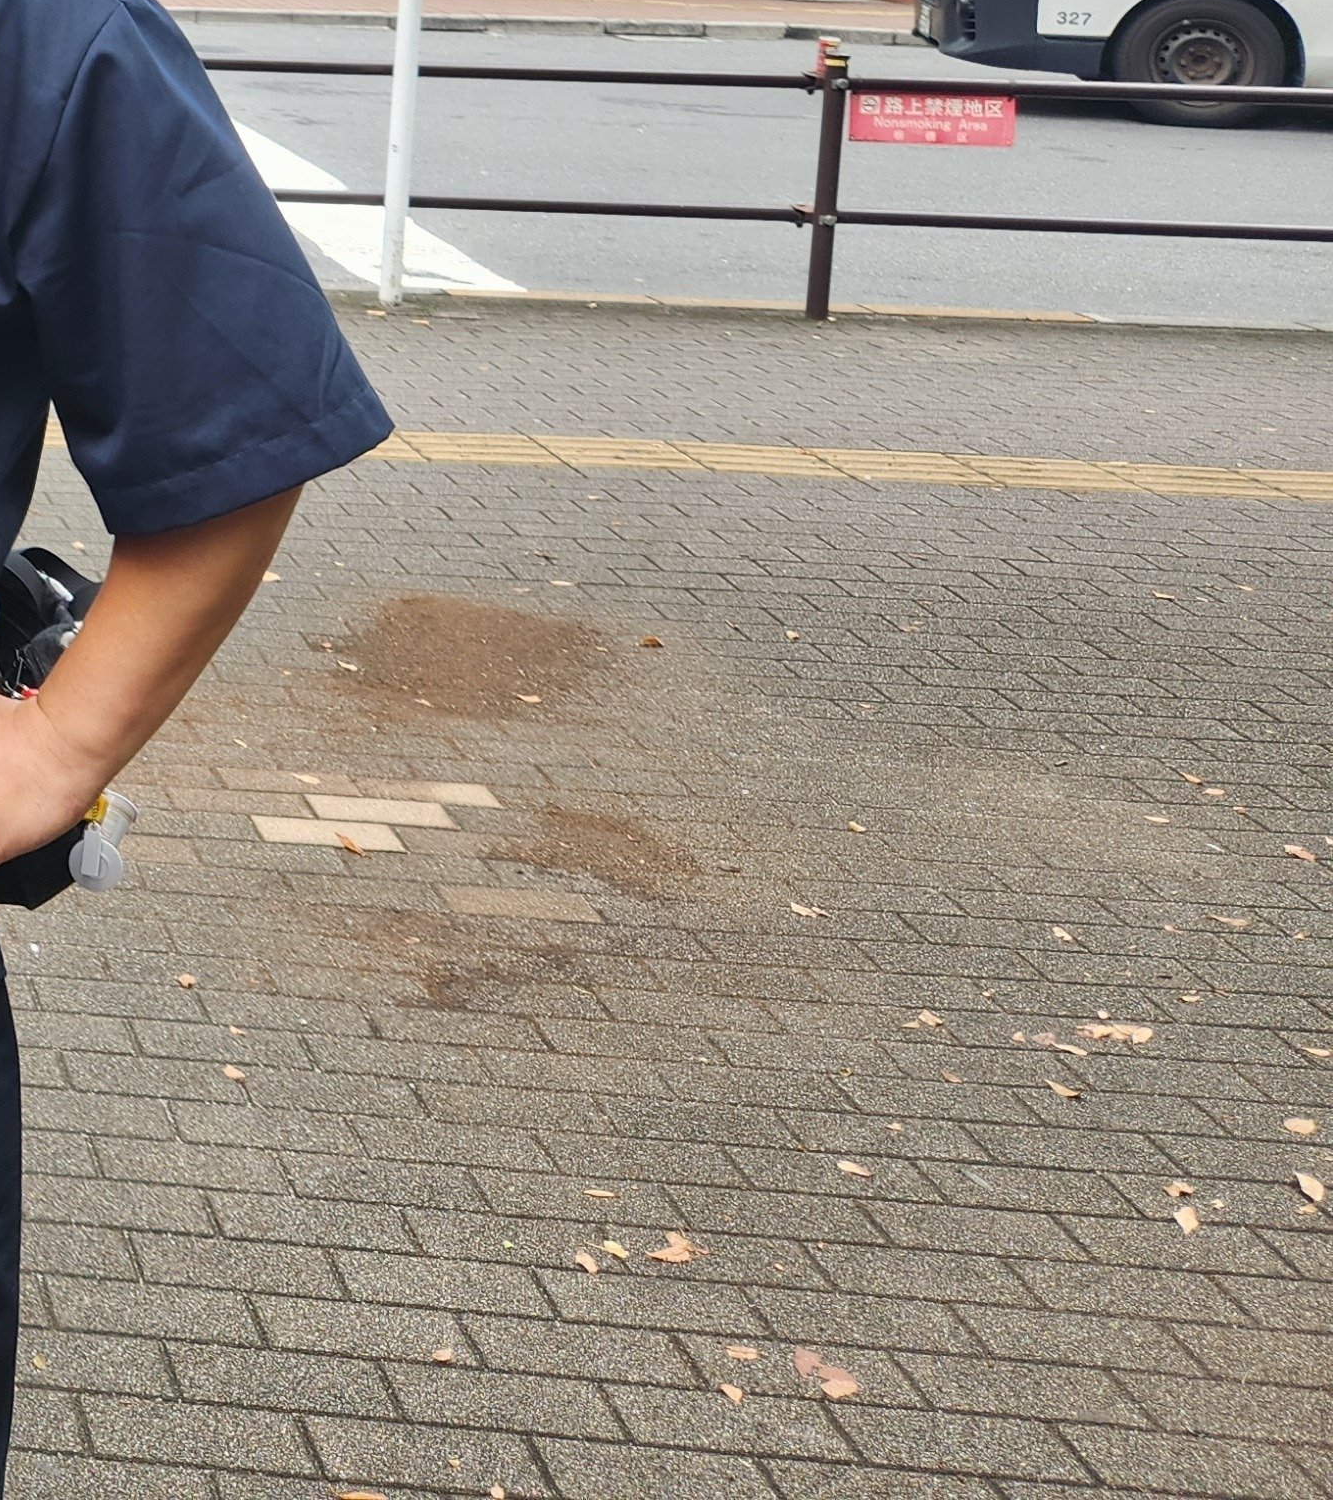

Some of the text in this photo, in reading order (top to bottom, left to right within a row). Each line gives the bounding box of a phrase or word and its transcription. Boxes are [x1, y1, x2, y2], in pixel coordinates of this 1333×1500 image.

[1056, 11, 1092, 26] 327
[885, 96, 1004, 118] 路上禁煙地区
[873, 116, 989, 132] Nonsmoking Area
